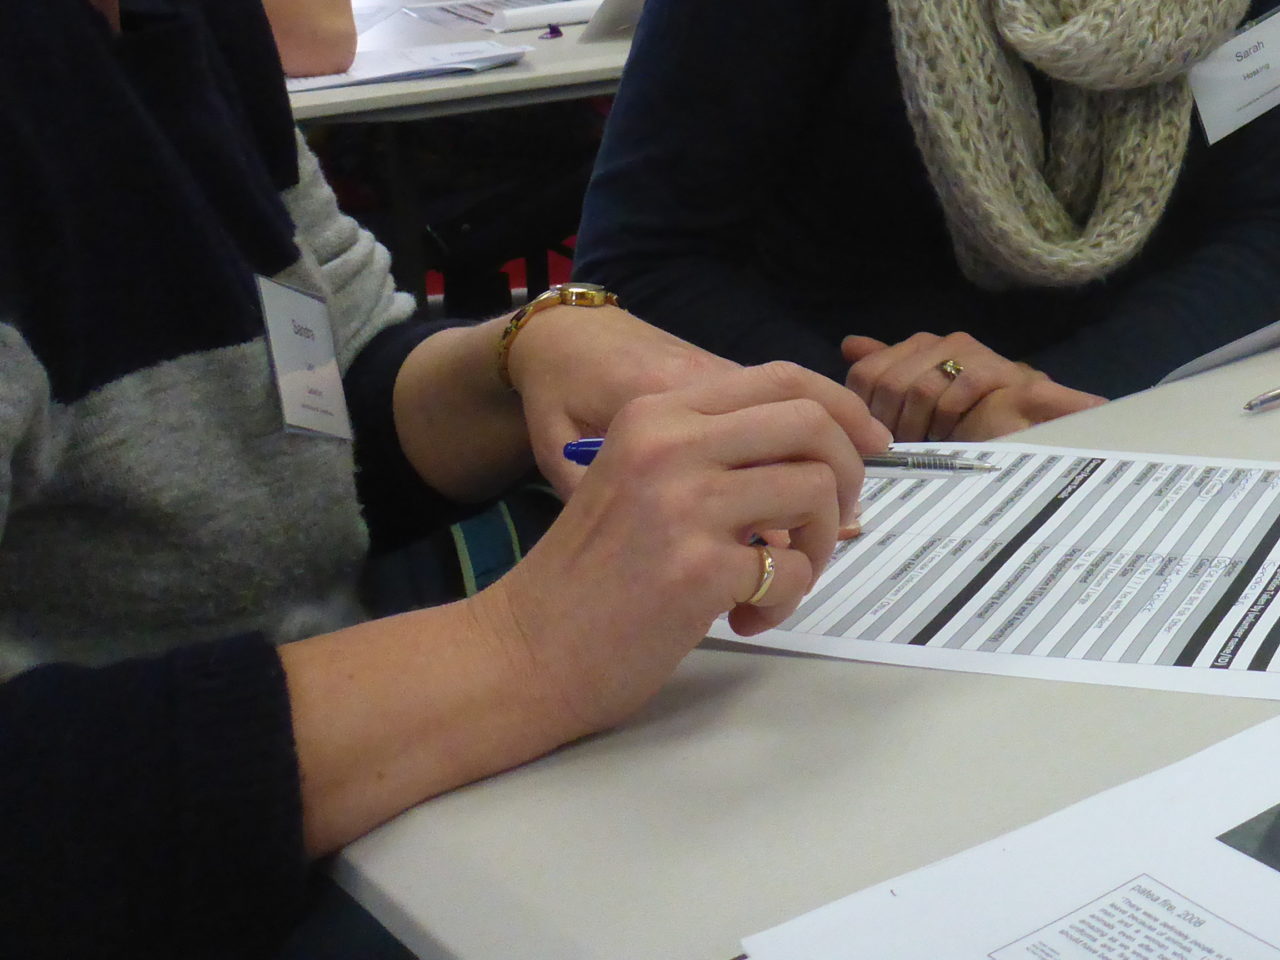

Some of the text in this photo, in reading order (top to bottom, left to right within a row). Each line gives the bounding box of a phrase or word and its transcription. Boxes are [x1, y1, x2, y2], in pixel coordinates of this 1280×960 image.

[1235, 40, 1265, 62] Sarah
[1254, 591, 1274, 604] Taken
[1231, 611, 1260, 637] (volunteer
[1212, 637, 1242, 665] name/ID)
